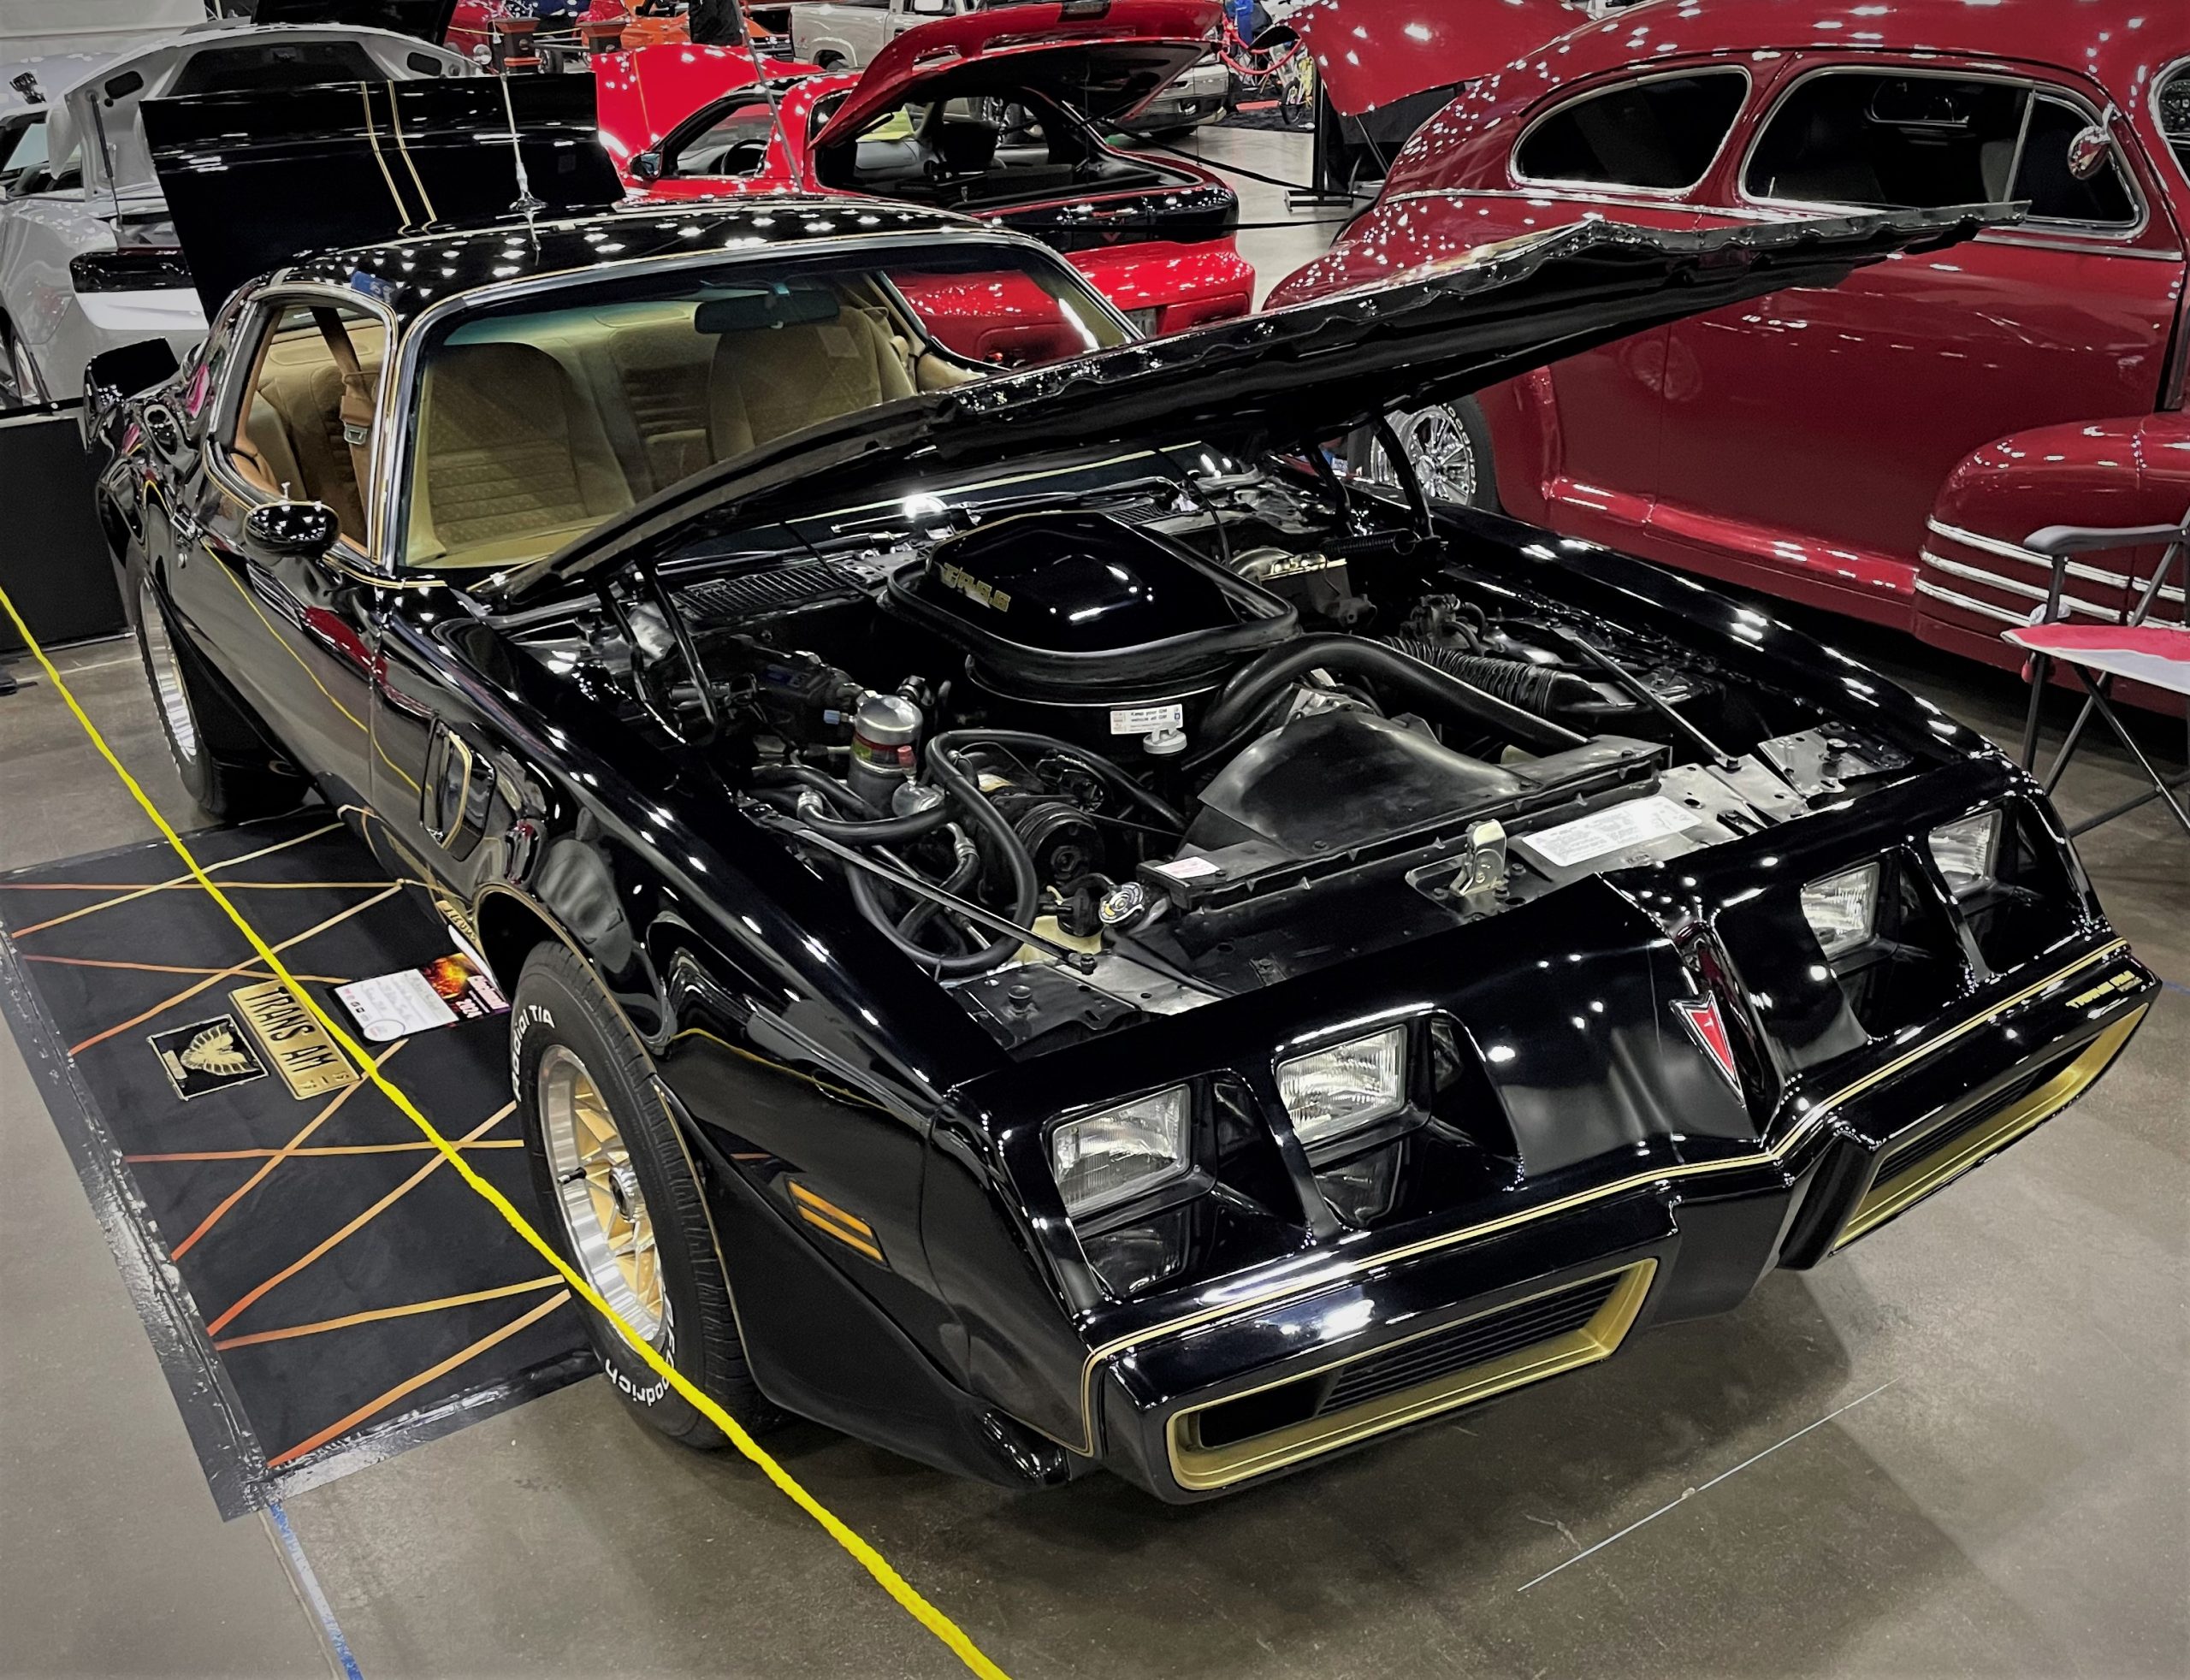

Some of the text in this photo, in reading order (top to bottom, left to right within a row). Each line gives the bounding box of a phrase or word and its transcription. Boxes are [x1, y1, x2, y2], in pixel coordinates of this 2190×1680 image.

[1441, 402, 1477, 494] oodrich
[244, 985, 339, 1073] TRANS AM
[455, 998, 483, 1019] 2024
[528, 1004, 555, 1028] T/A
